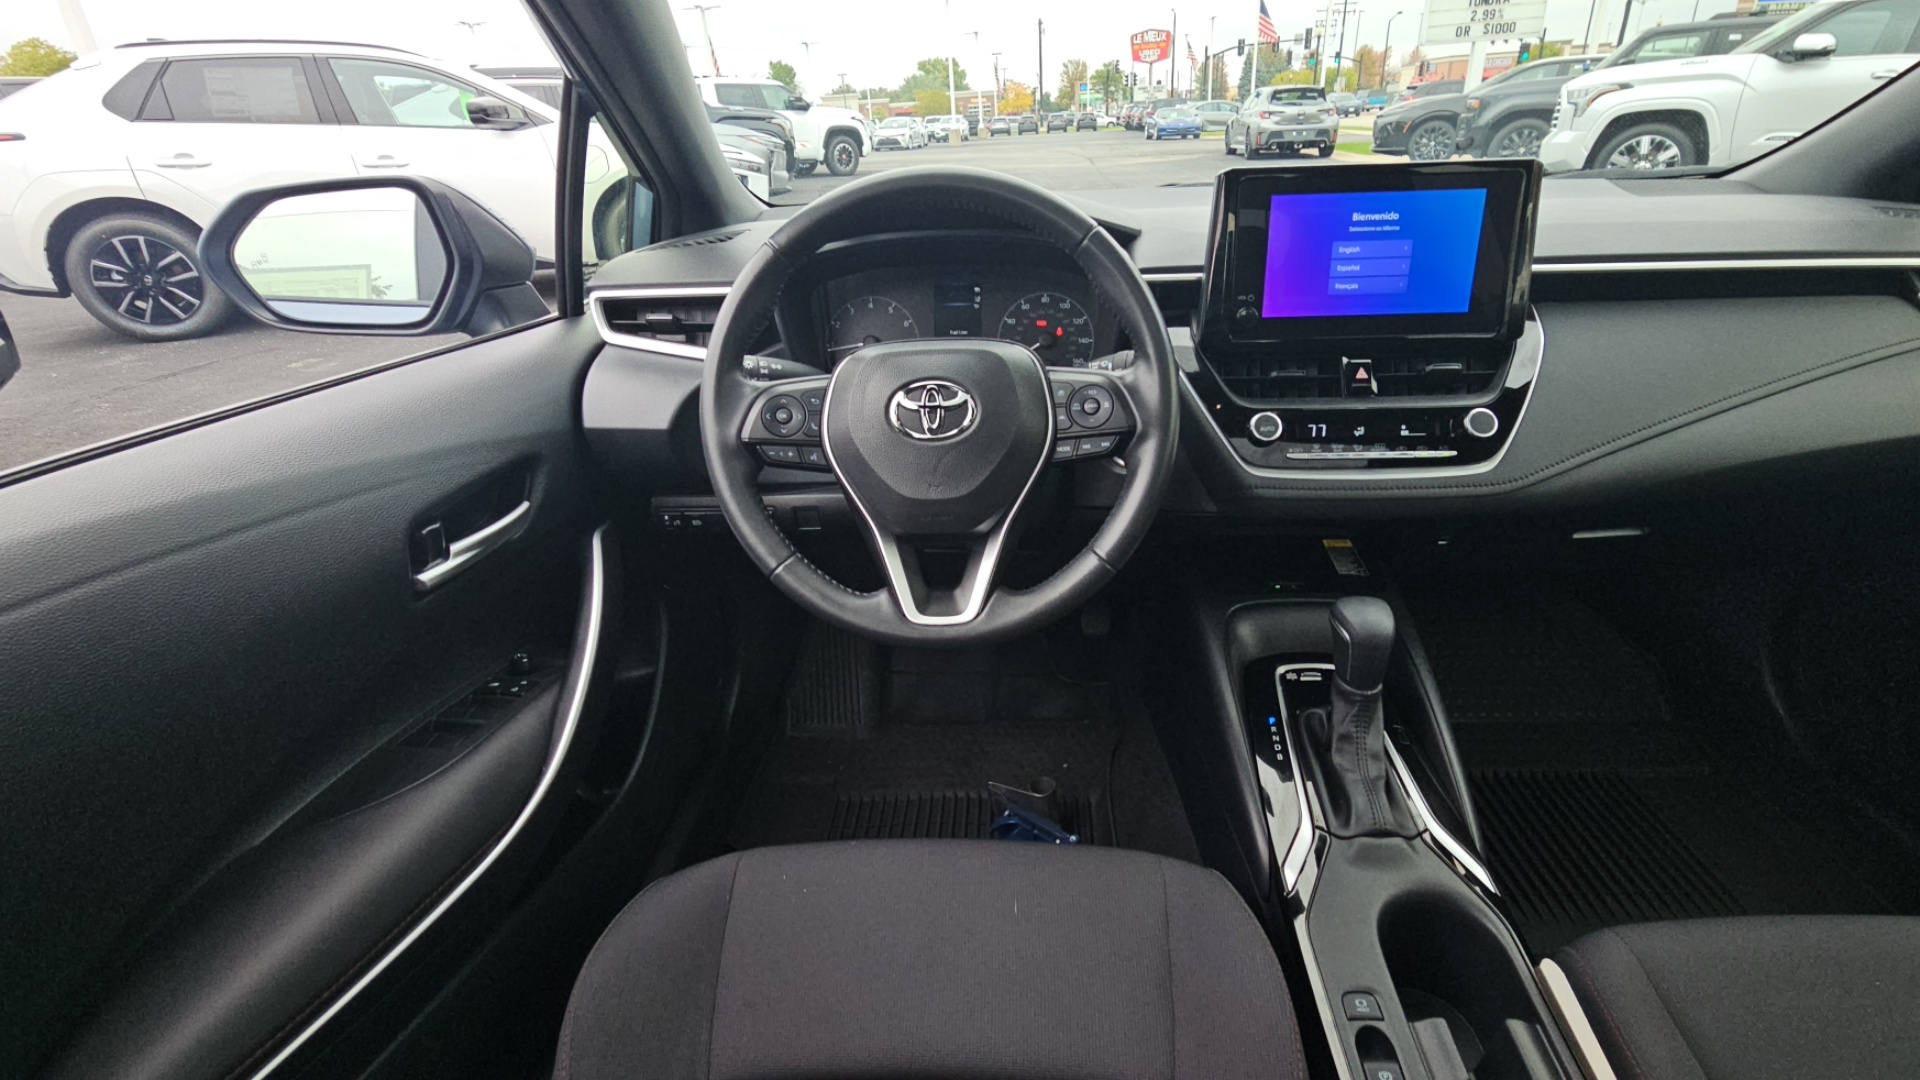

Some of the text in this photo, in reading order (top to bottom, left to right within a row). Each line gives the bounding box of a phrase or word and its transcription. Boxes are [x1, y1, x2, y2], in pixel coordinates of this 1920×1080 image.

[1470, 8, 1504, 22] 2.99%
[1456, 25, 1471, 37] OR
[1133, 33, 1142, 44] LE
[1352, 211, 1400, 221] Bienvenido
[1338, 246, 1361, 255] English
[1336, 264, 1360, 272] Español
[1334, 283, 1359, 291] Français
[1307, 424, 1327, 438] 77
